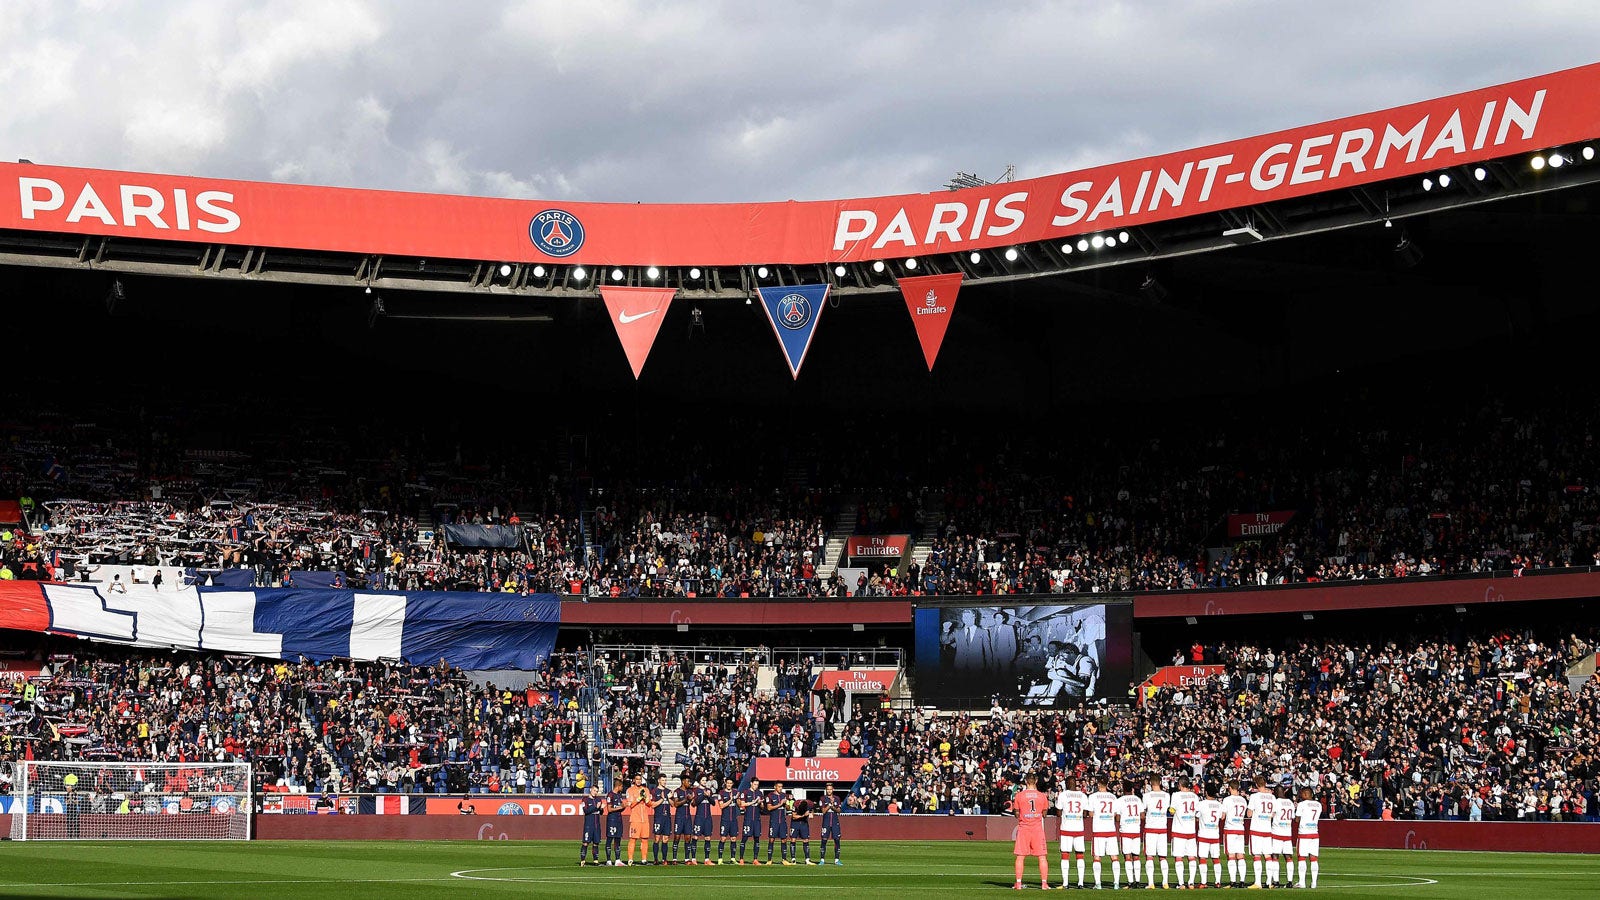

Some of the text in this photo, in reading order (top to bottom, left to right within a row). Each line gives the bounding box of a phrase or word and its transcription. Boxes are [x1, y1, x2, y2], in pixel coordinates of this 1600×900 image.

[832, 89, 1547, 250] PARIS SAINT-GERMAIN
[18, 176, 242, 233] PARIS
[538, 212, 574, 225] PARIS
[782, 295, 805, 305] PARIS
[916, 305, 947, 315] Emirates
[1256, 513, 1270, 523] Fly
[871, 537, 885, 546] Fly
[856, 545, 900, 556] Emirates
[853, 671, 867, 680] Fly
[1193, 666, 1205, 676] Fly
[838, 680, 882, 691] Emirates
[804, 758, 821, 769] Fly
[786, 767, 839, 781] Emirates
[1029, 799, 1037, 812] 1
[1067, 800, 1082, 814] 13
[1100, 800, 1113, 814] 21
[1126, 804, 1139, 817] 11
[1155, 799, 1163, 811] 4
[1182, 800, 1195, 814] 14
[1234, 804, 1245, 817] 12
[1261, 801, 1273, 814] 19
[1210, 810, 1217, 823] 5
[1280, 808, 1293, 821] 20
[1311, 809, 1317, 821] 7
